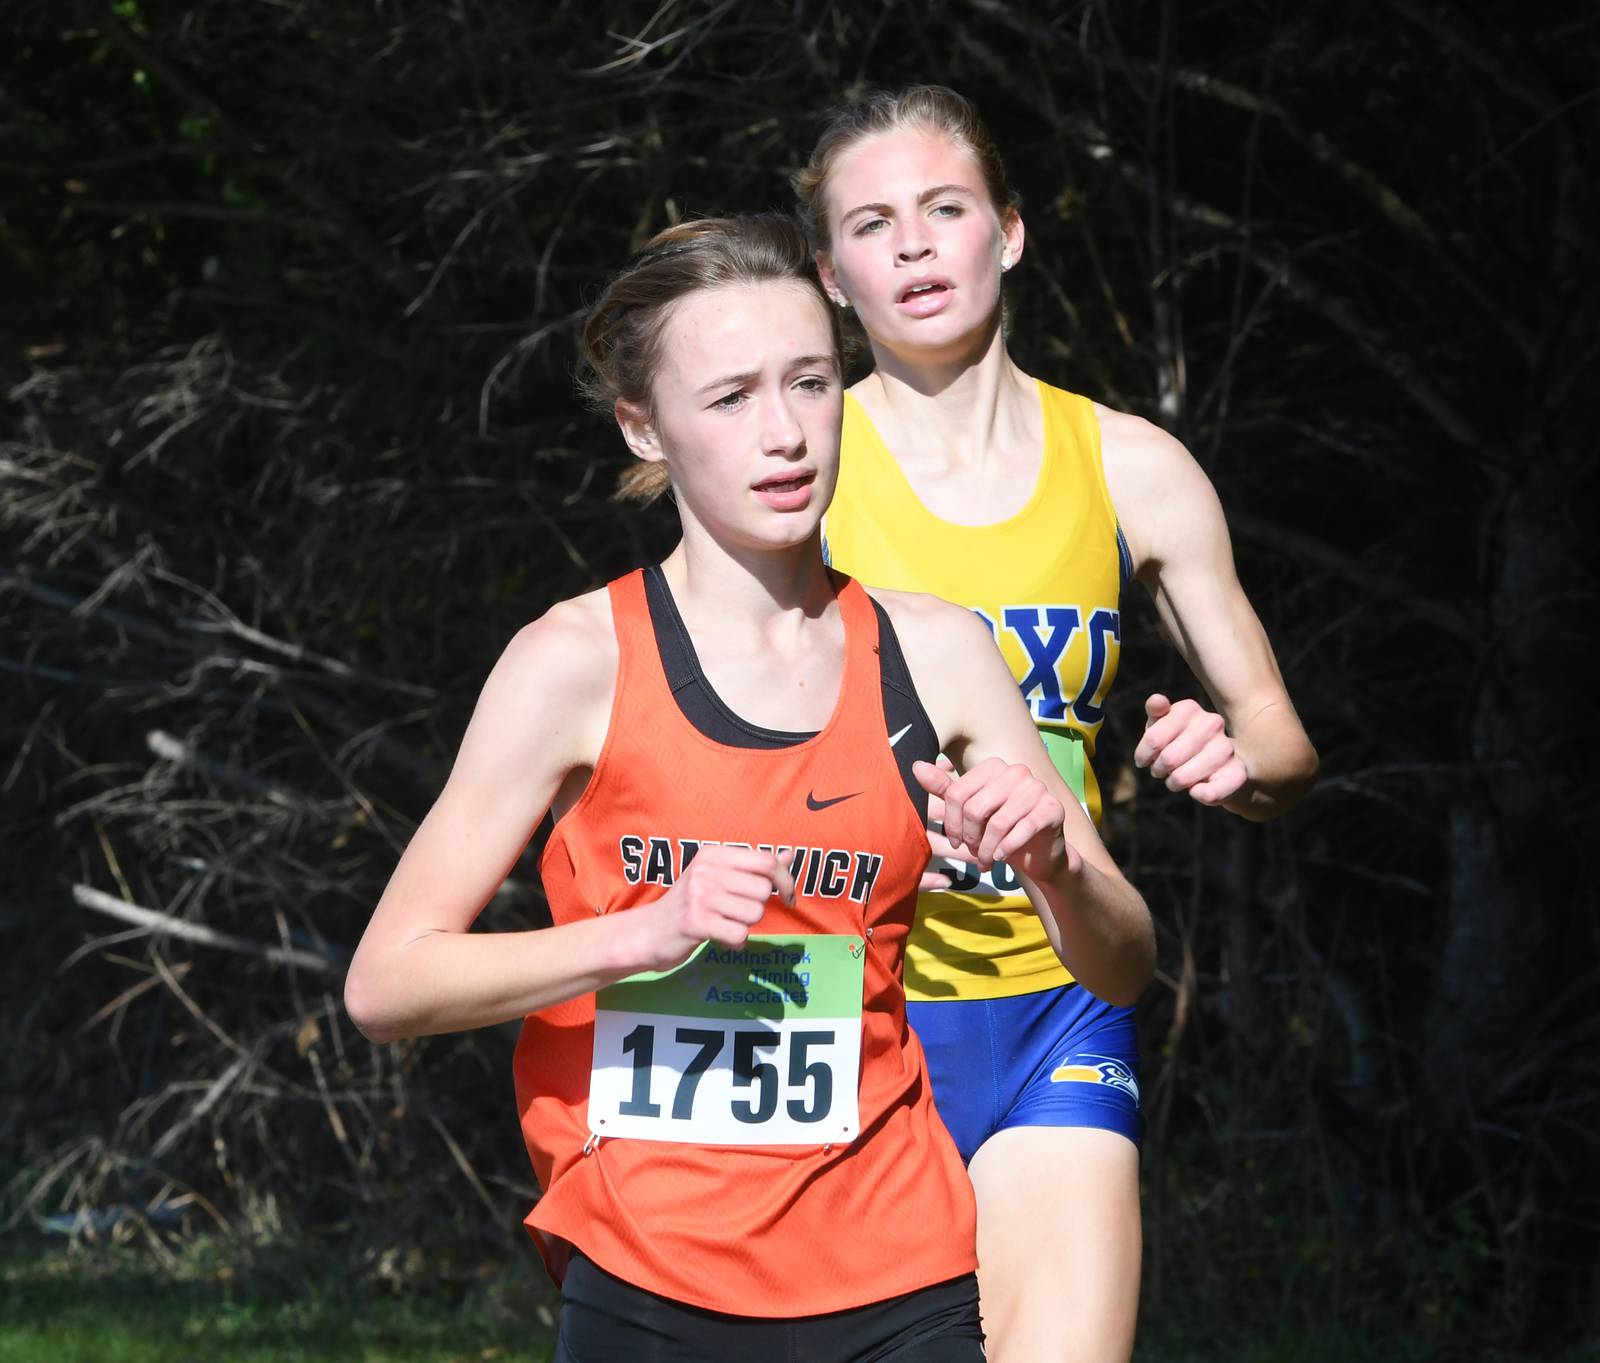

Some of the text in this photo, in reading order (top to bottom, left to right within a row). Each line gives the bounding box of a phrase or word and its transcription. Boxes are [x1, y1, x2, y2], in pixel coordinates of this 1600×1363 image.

[971, 605, 1121, 726] XC
[620, 835, 884, 904] SAICH
[704, 946, 811, 965] AdkinsTrak
[751, 968, 811, 987] Timing
[704, 986, 810, 1004] Associates
[618, 1024, 836, 1124] 1755
